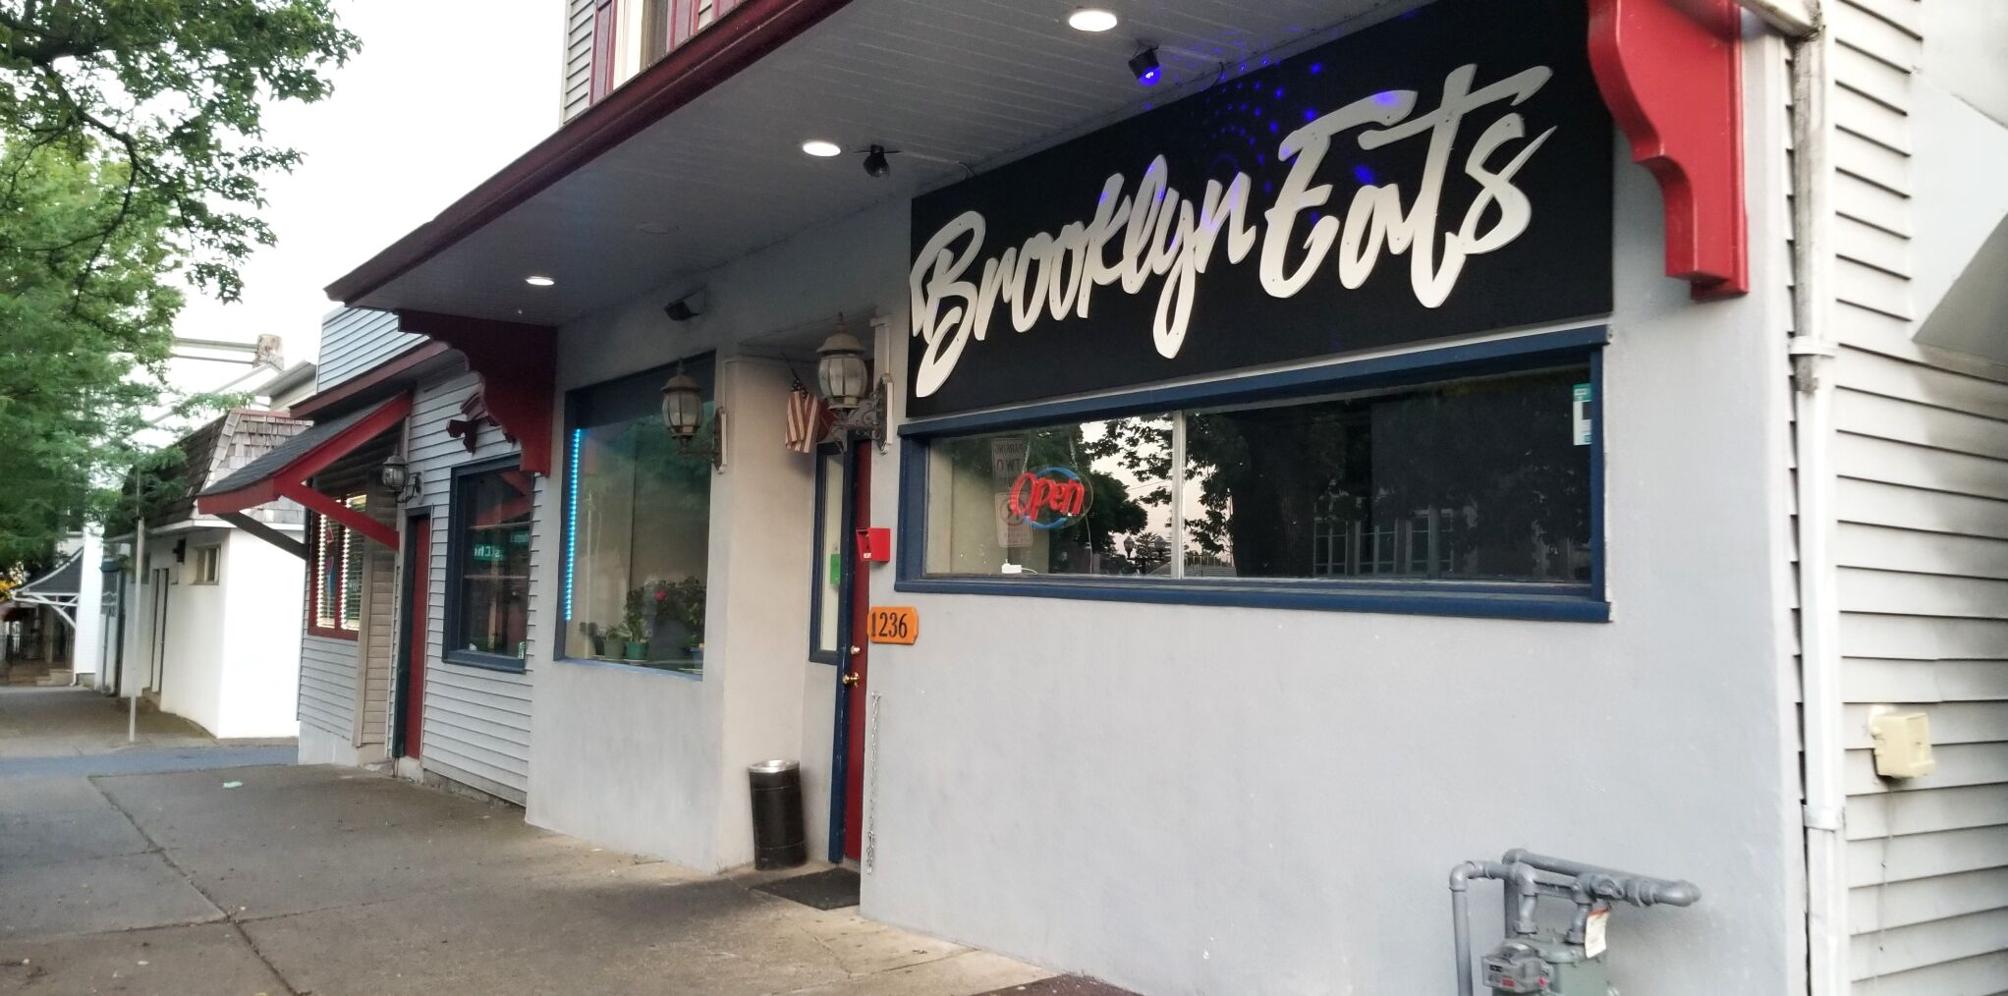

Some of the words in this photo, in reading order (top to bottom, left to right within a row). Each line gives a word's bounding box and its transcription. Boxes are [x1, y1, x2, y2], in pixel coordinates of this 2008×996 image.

[910, 154, 1256, 397] Brooklyn
[1259, 64, 1557, 308] Eats
[1009, 472, 1085, 521] Open
[870, 611, 908, 639] 1236
